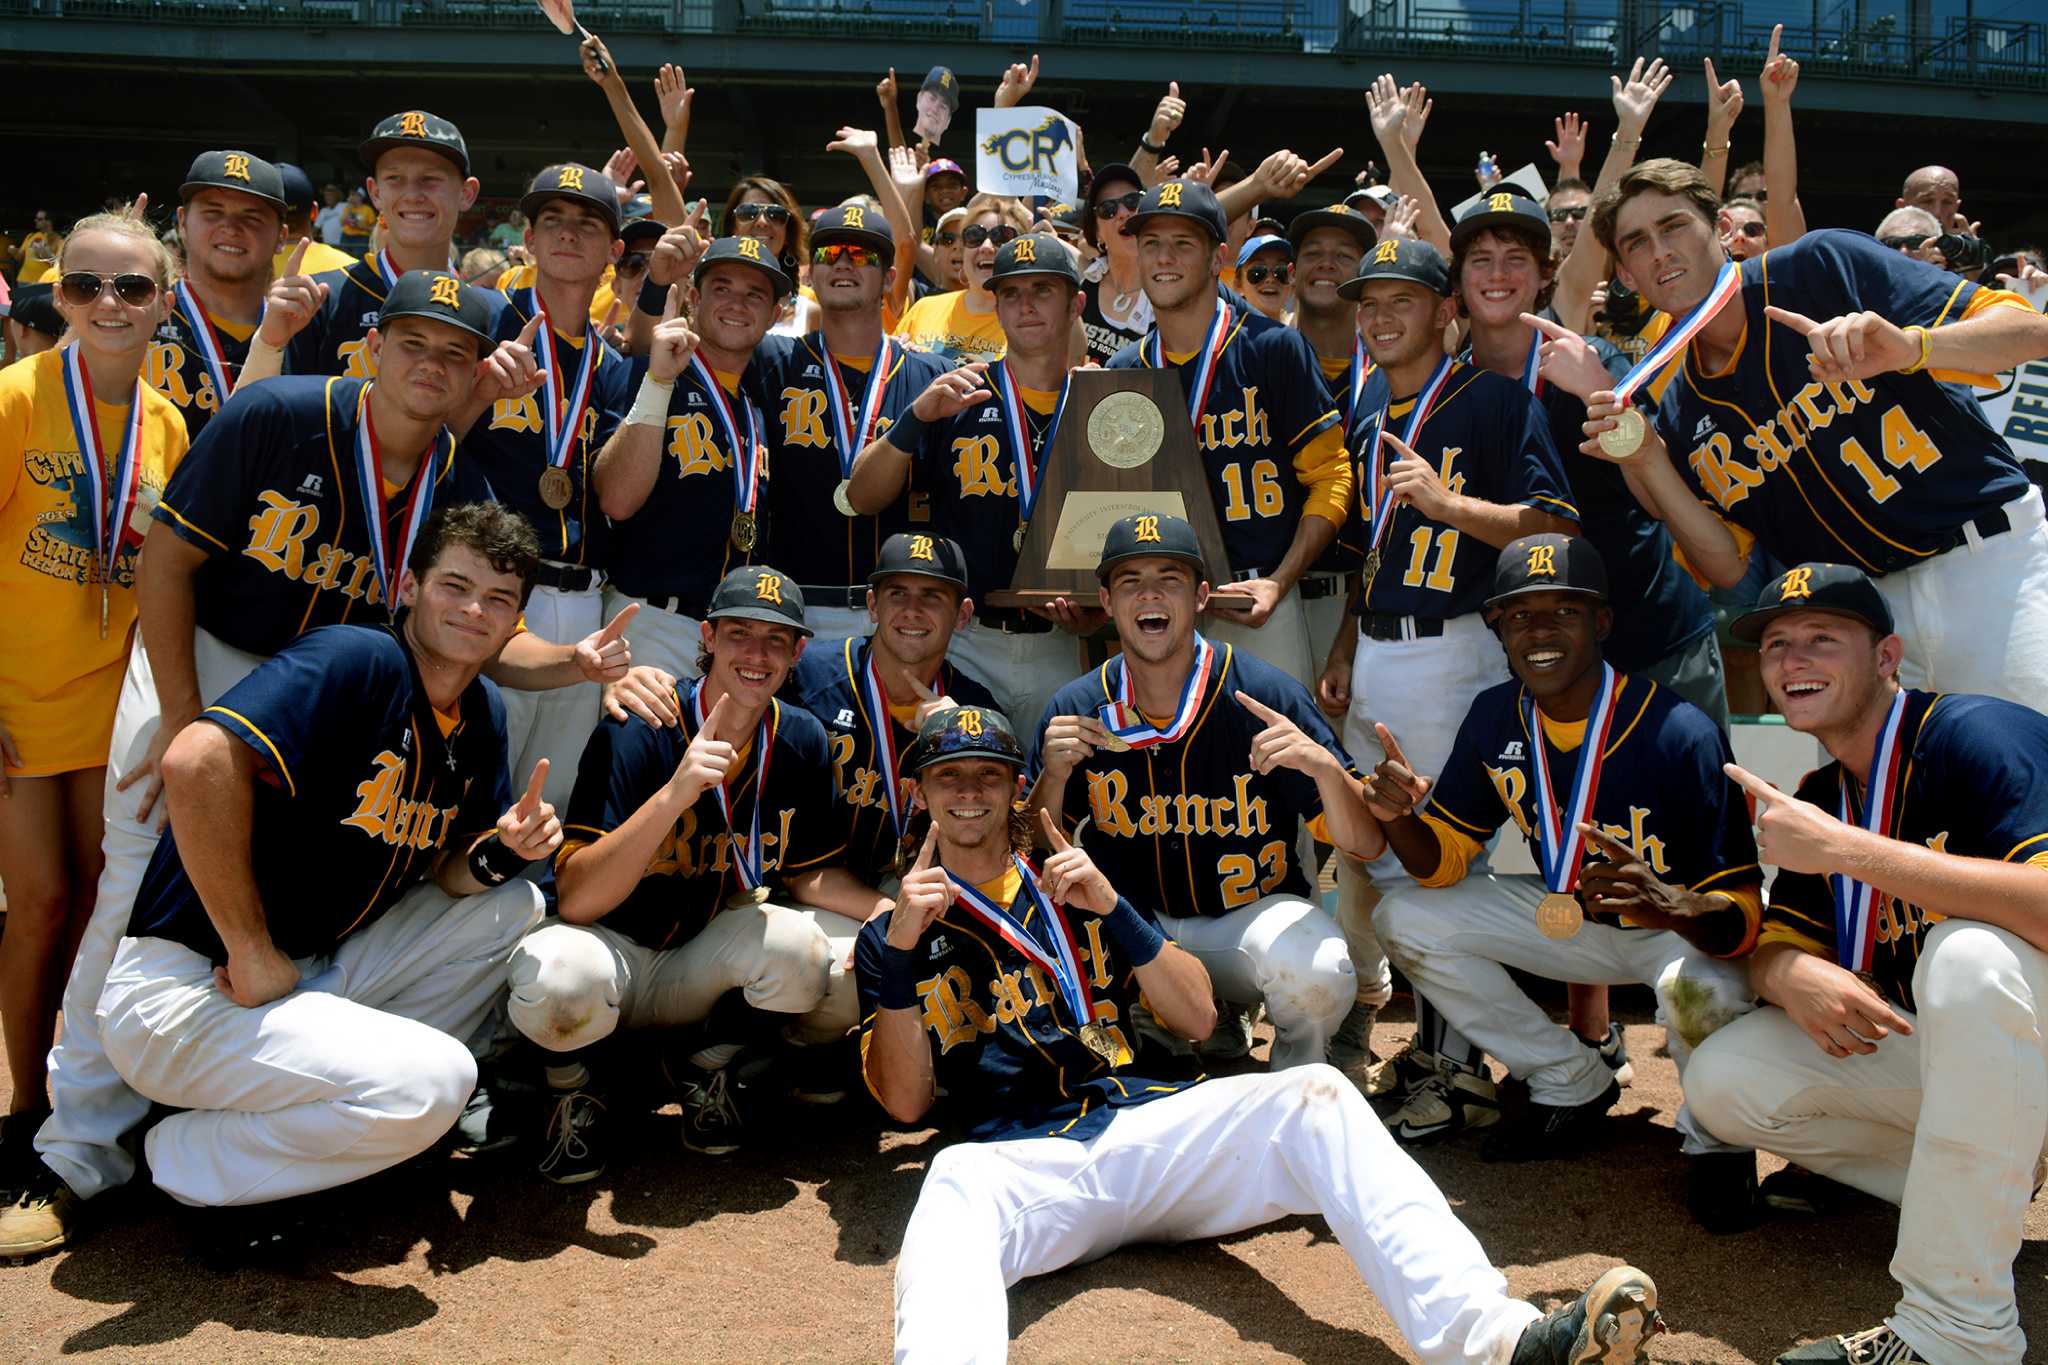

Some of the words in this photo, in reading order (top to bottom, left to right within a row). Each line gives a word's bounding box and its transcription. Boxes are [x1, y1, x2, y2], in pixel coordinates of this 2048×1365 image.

[399, 111, 427, 138] R
[999, 128, 1059, 176] CR
[224, 153, 251, 181] R
[559, 166, 585, 191] R
[1158, 181, 1184, 207] R
[1490, 192, 1513, 213] R
[843, 206, 865, 229] R
[737, 236, 761, 261] R
[1014, 239, 1036, 262] R
[1375, 239, 1399, 264] R
[431, 275, 460, 310] R
[1839, 403, 1944, 505] 14
[1221, 458, 1285, 522] 16
[1135, 515, 1161, 543] R
[910, 535, 934, 561] R
[1402, 525, 1460, 593] 11
[1526, 545, 1557, 577] R
[756, 573, 783, 606] R
[1780, 566, 1813, 601] R
[1085, 768, 1271, 838] Ranch
[1216, 839, 1288, 910] 23
